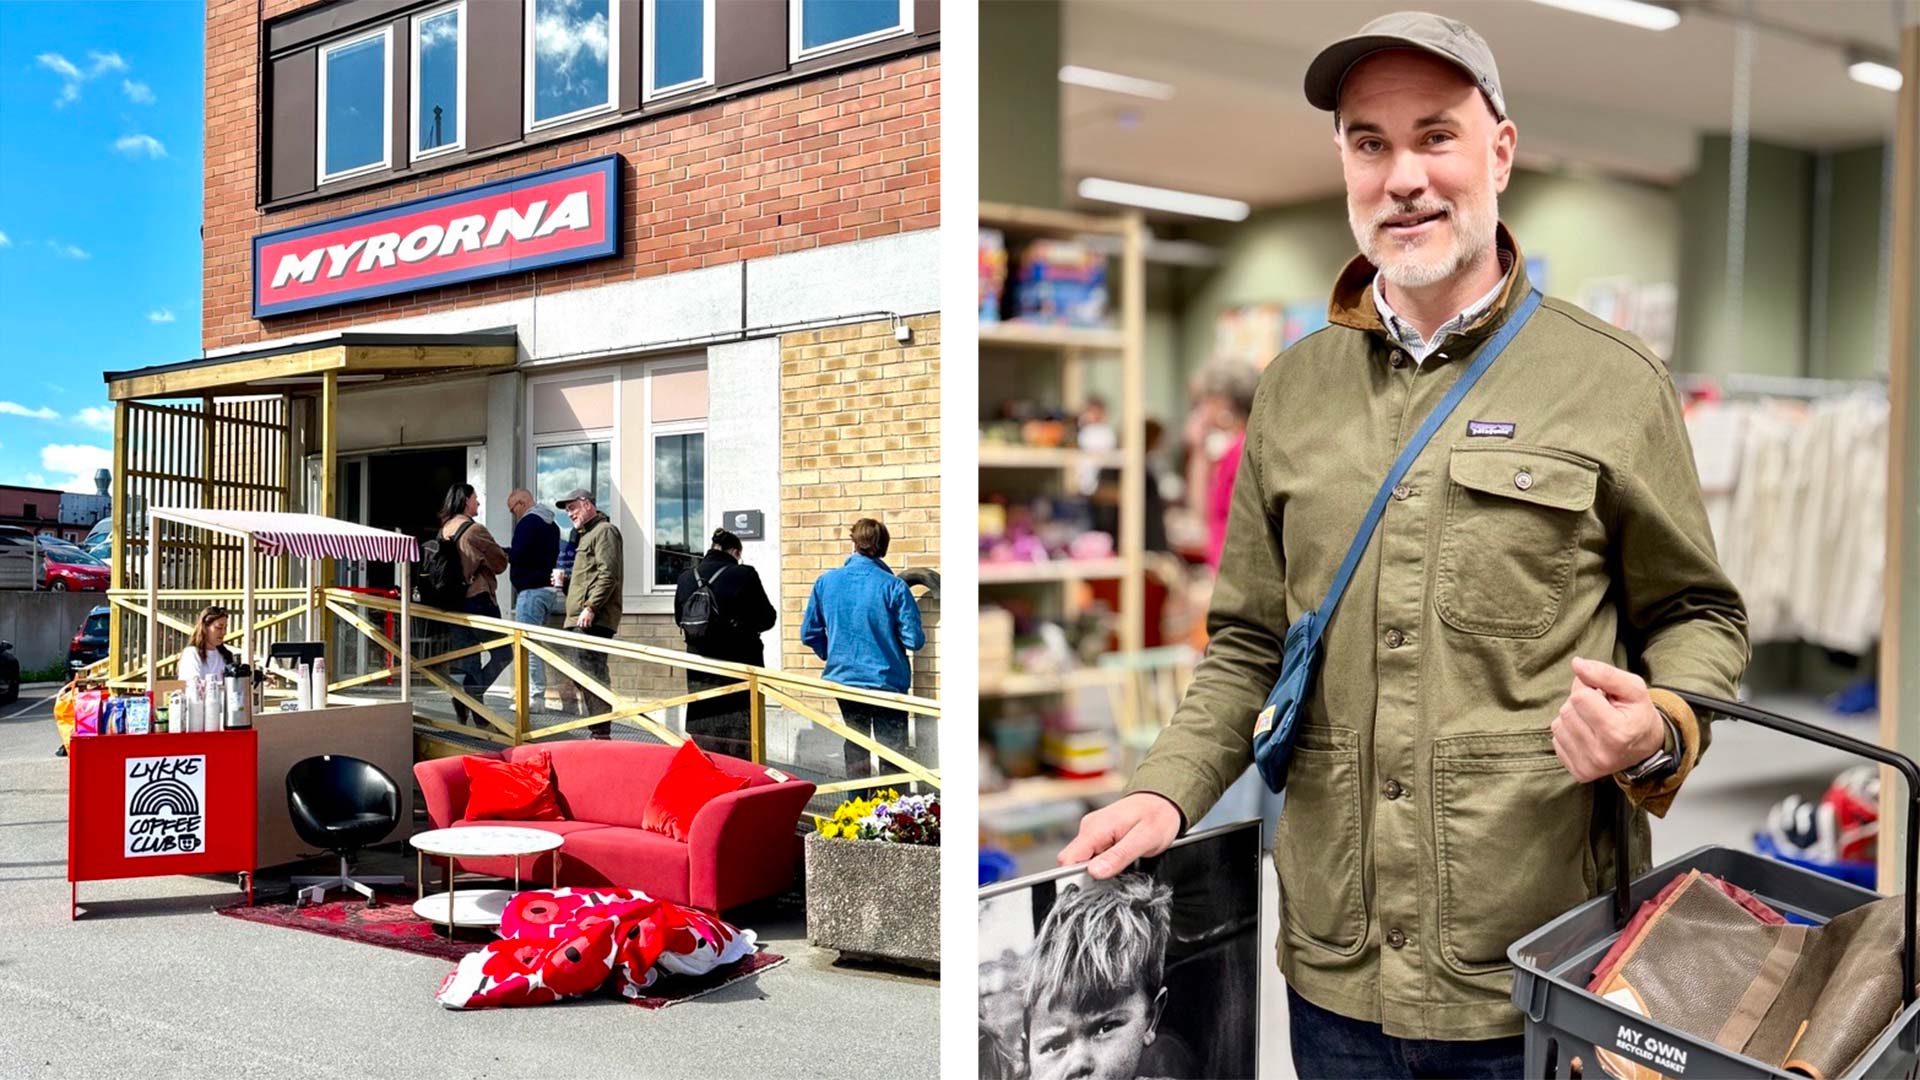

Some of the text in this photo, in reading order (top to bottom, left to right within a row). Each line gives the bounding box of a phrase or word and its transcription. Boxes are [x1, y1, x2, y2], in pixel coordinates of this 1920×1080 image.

[270, 190, 592, 289] MYRORNA
[129, 757, 202, 779] LYKKE
[129, 815, 202, 836] COFFEE
[130, 835, 177, 853] CLUB
[1616, 1039, 1686, 1074] RECYCLED BASKET
[1617, 1025, 1688, 1065] MY OWN
